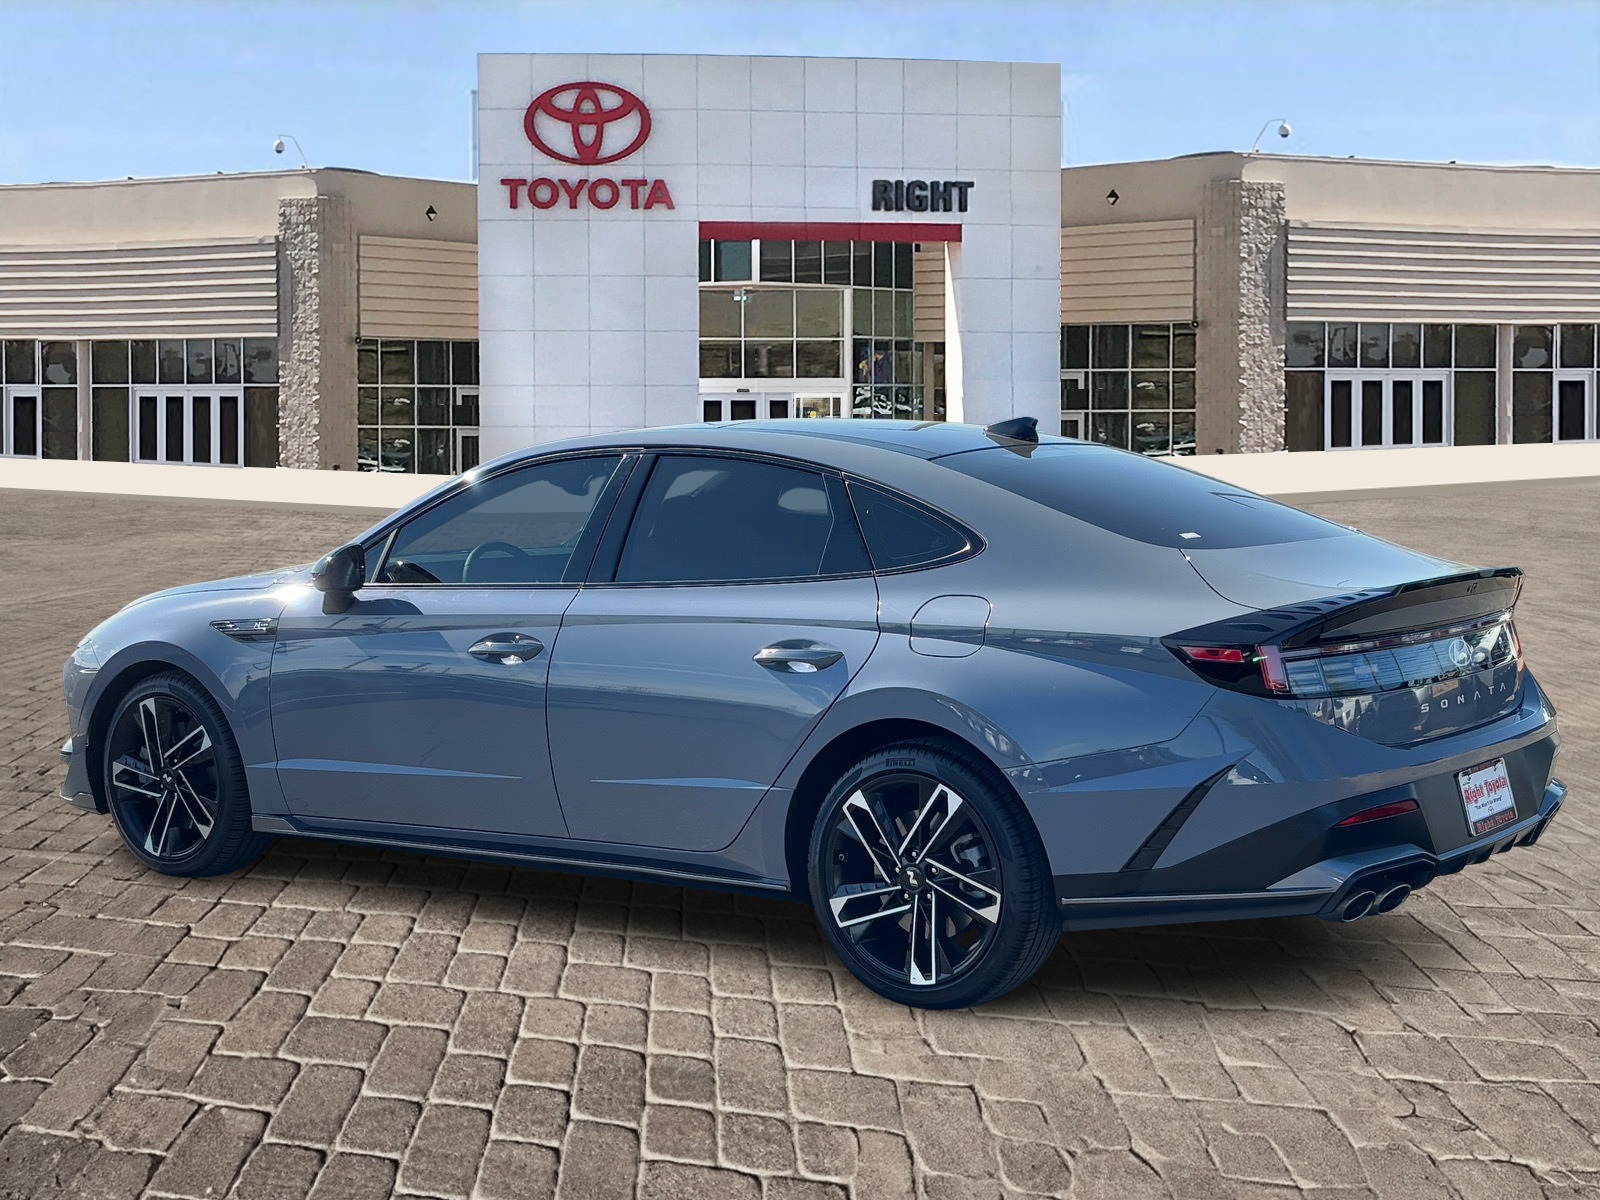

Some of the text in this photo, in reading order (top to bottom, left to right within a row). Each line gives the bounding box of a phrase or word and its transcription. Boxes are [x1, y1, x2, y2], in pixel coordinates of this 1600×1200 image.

[500, 178, 675, 210] TOYOTA
[872, 180, 975, 213] RIGHT
[1420, 682, 1506, 713] SONATA
[885, 757, 916, 767] PIRELLI
[1464, 776, 1508, 804] Right Toyota
